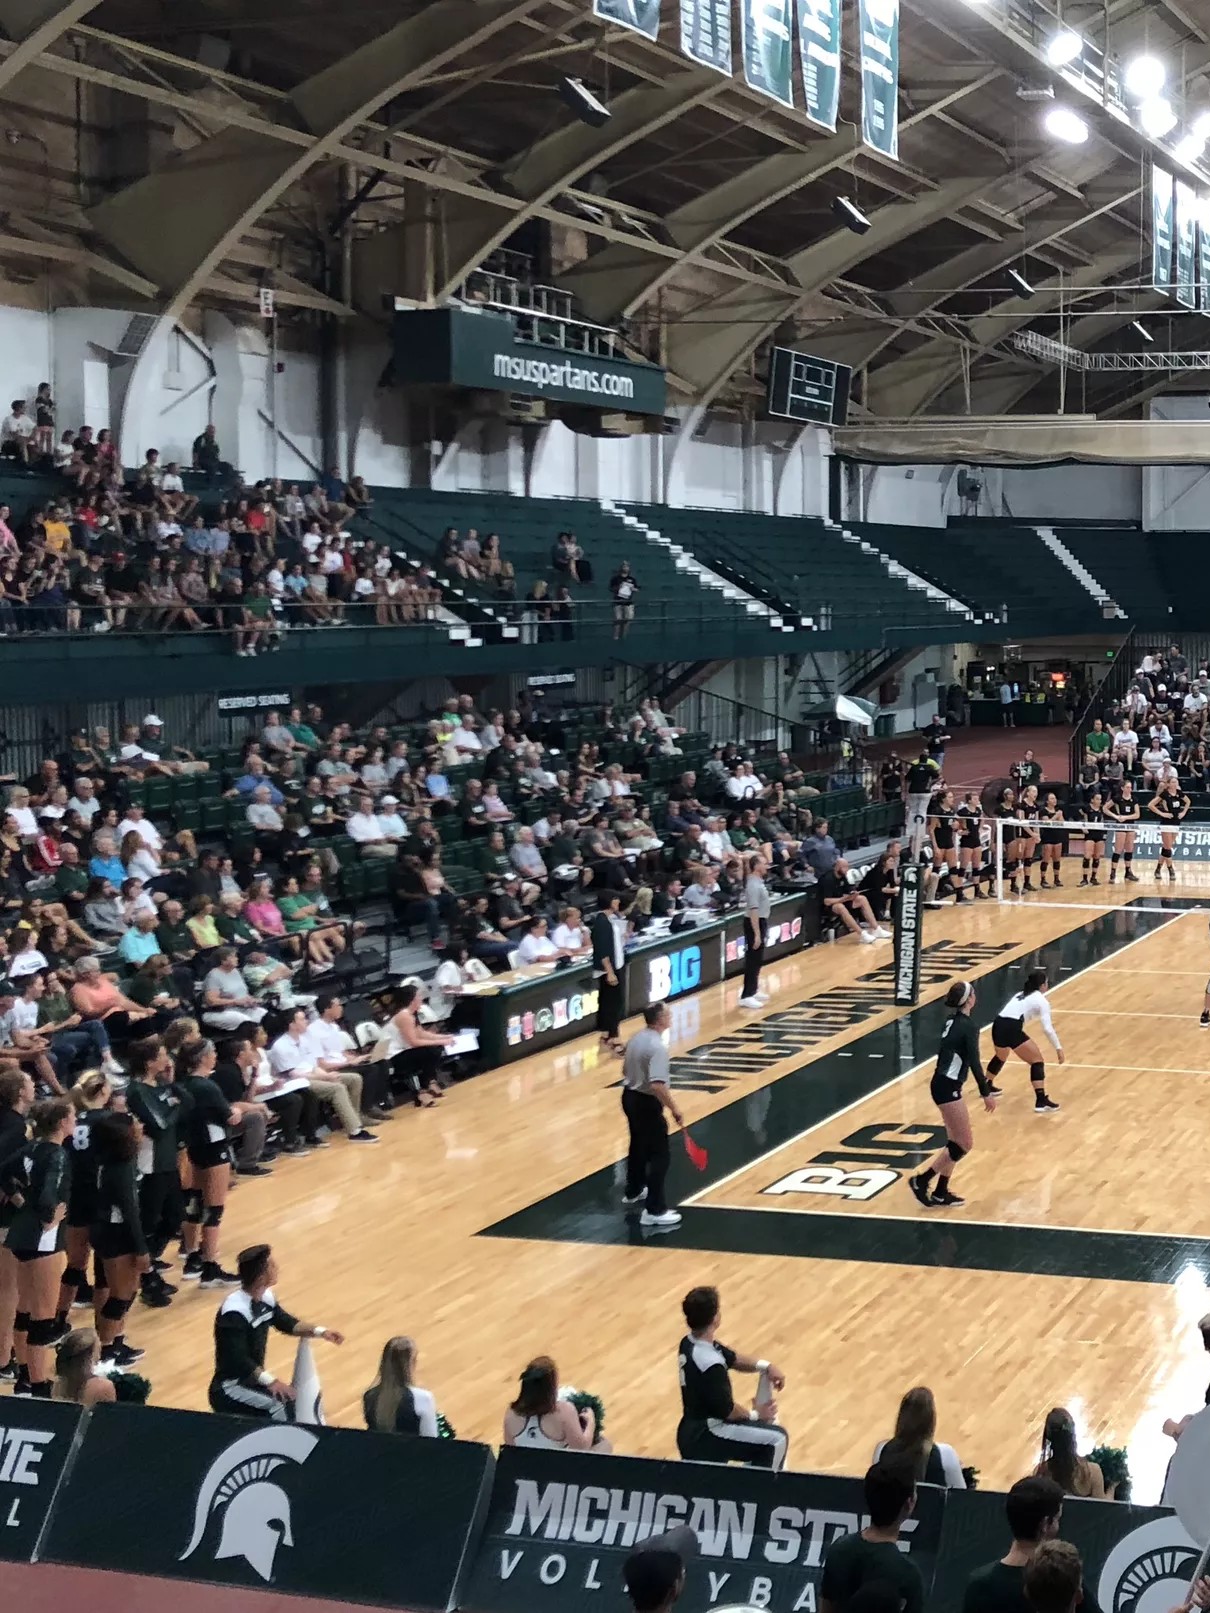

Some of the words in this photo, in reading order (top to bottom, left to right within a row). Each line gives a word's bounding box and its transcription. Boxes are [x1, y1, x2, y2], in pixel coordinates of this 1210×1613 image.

[494, 353, 634, 399] msuspartans.com
[901, 888, 918, 929] STATE
[897, 931, 916, 1000] MICHIGAN
[72, 1125, 90, 1150] 8
[505, 1479, 758, 1559] MICHIGAN
